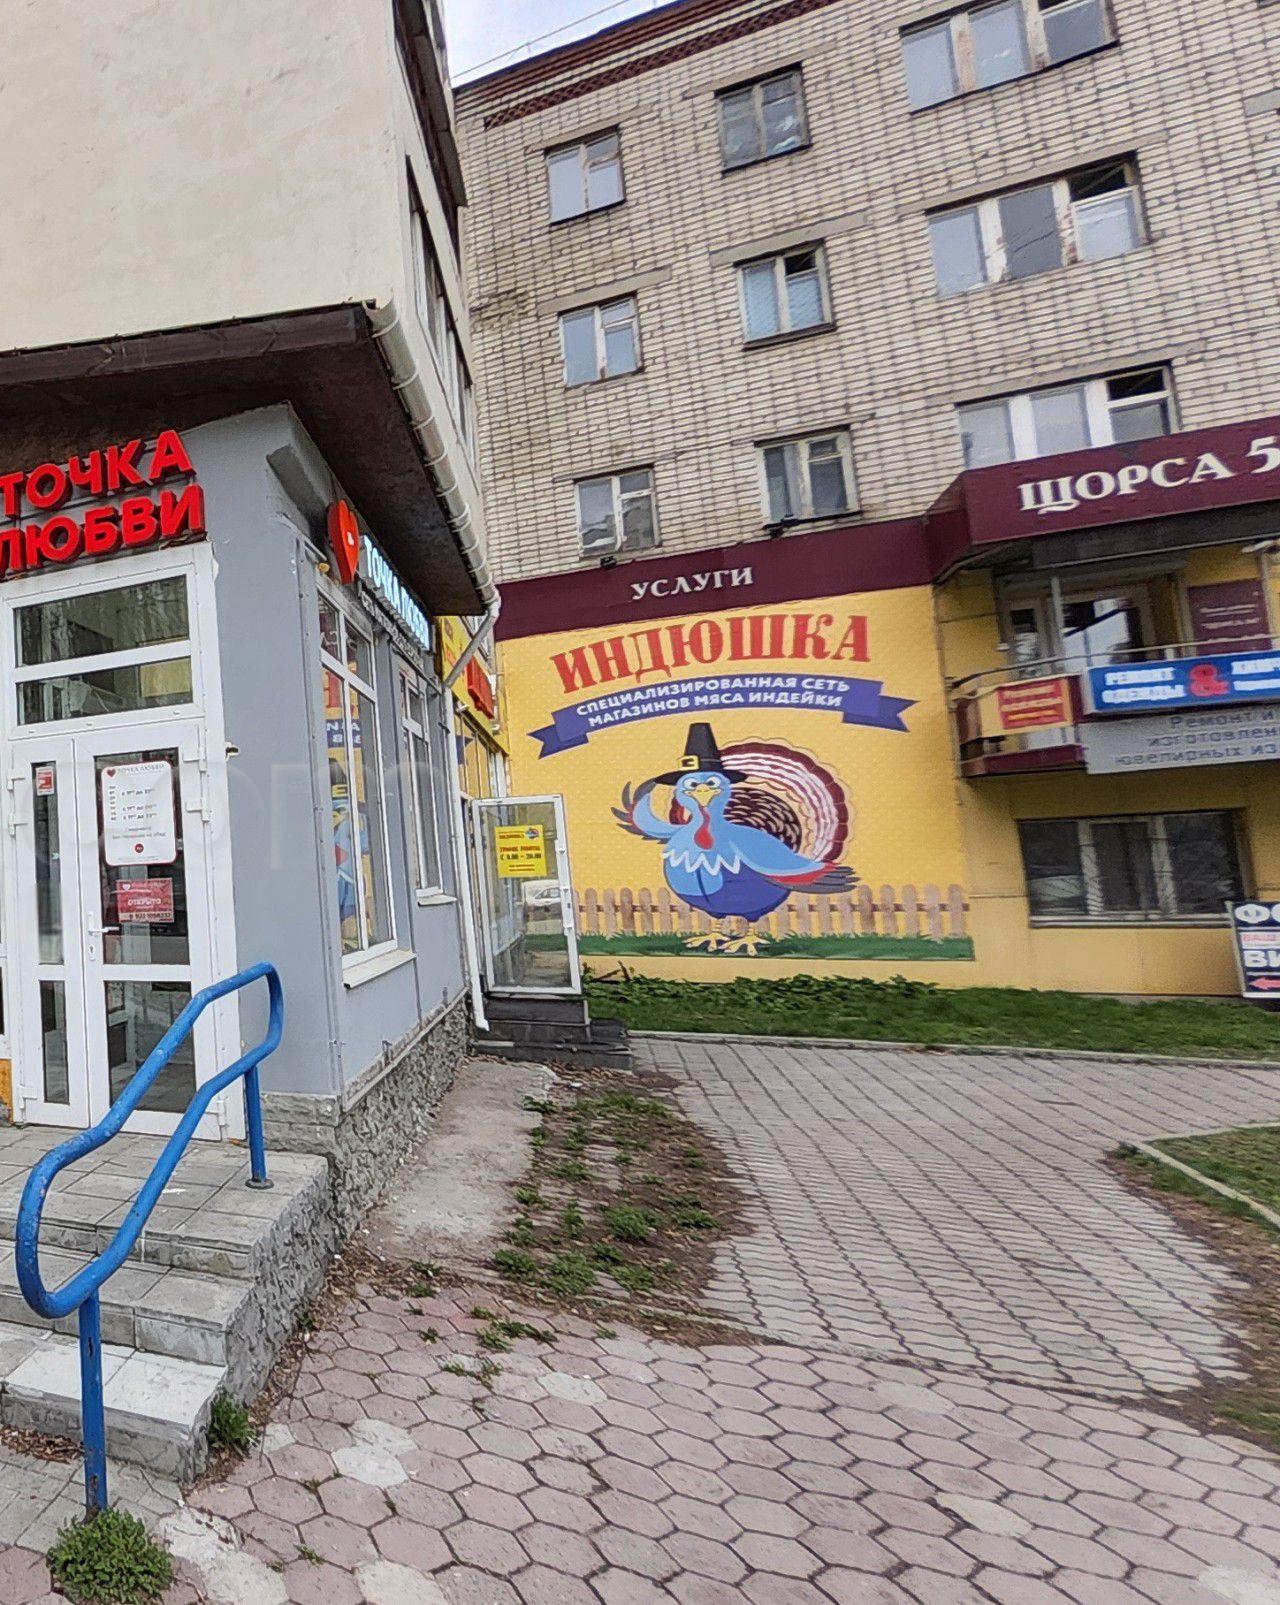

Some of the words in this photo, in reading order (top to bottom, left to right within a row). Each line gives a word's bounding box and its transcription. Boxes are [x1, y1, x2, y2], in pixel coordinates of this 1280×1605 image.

[1017, 452, 1238, 515] ЩОРСА
[1245, 435, 1280, 474] 5
[631, 567, 754, 600] УСЛУГИ
[550, 614, 871, 694] ИНДЮШКА
[576, 677, 797, 716] СПЕЦИАЛИЗИРОВАННАЯ
[801, 677, 851, 692] СЕТЬ
[588, 697, 690, 727] МАГАЗИНОВ
[694, 692, 744, 706] МЯСА
[748, 690, 843, 707] ИНДЕЙКИ
[1148, 726, 1280, 747] изготовлен
[1171, 712, 1252, 729] Ремонт
[1116, 747, 1242, 766] ювелирных
